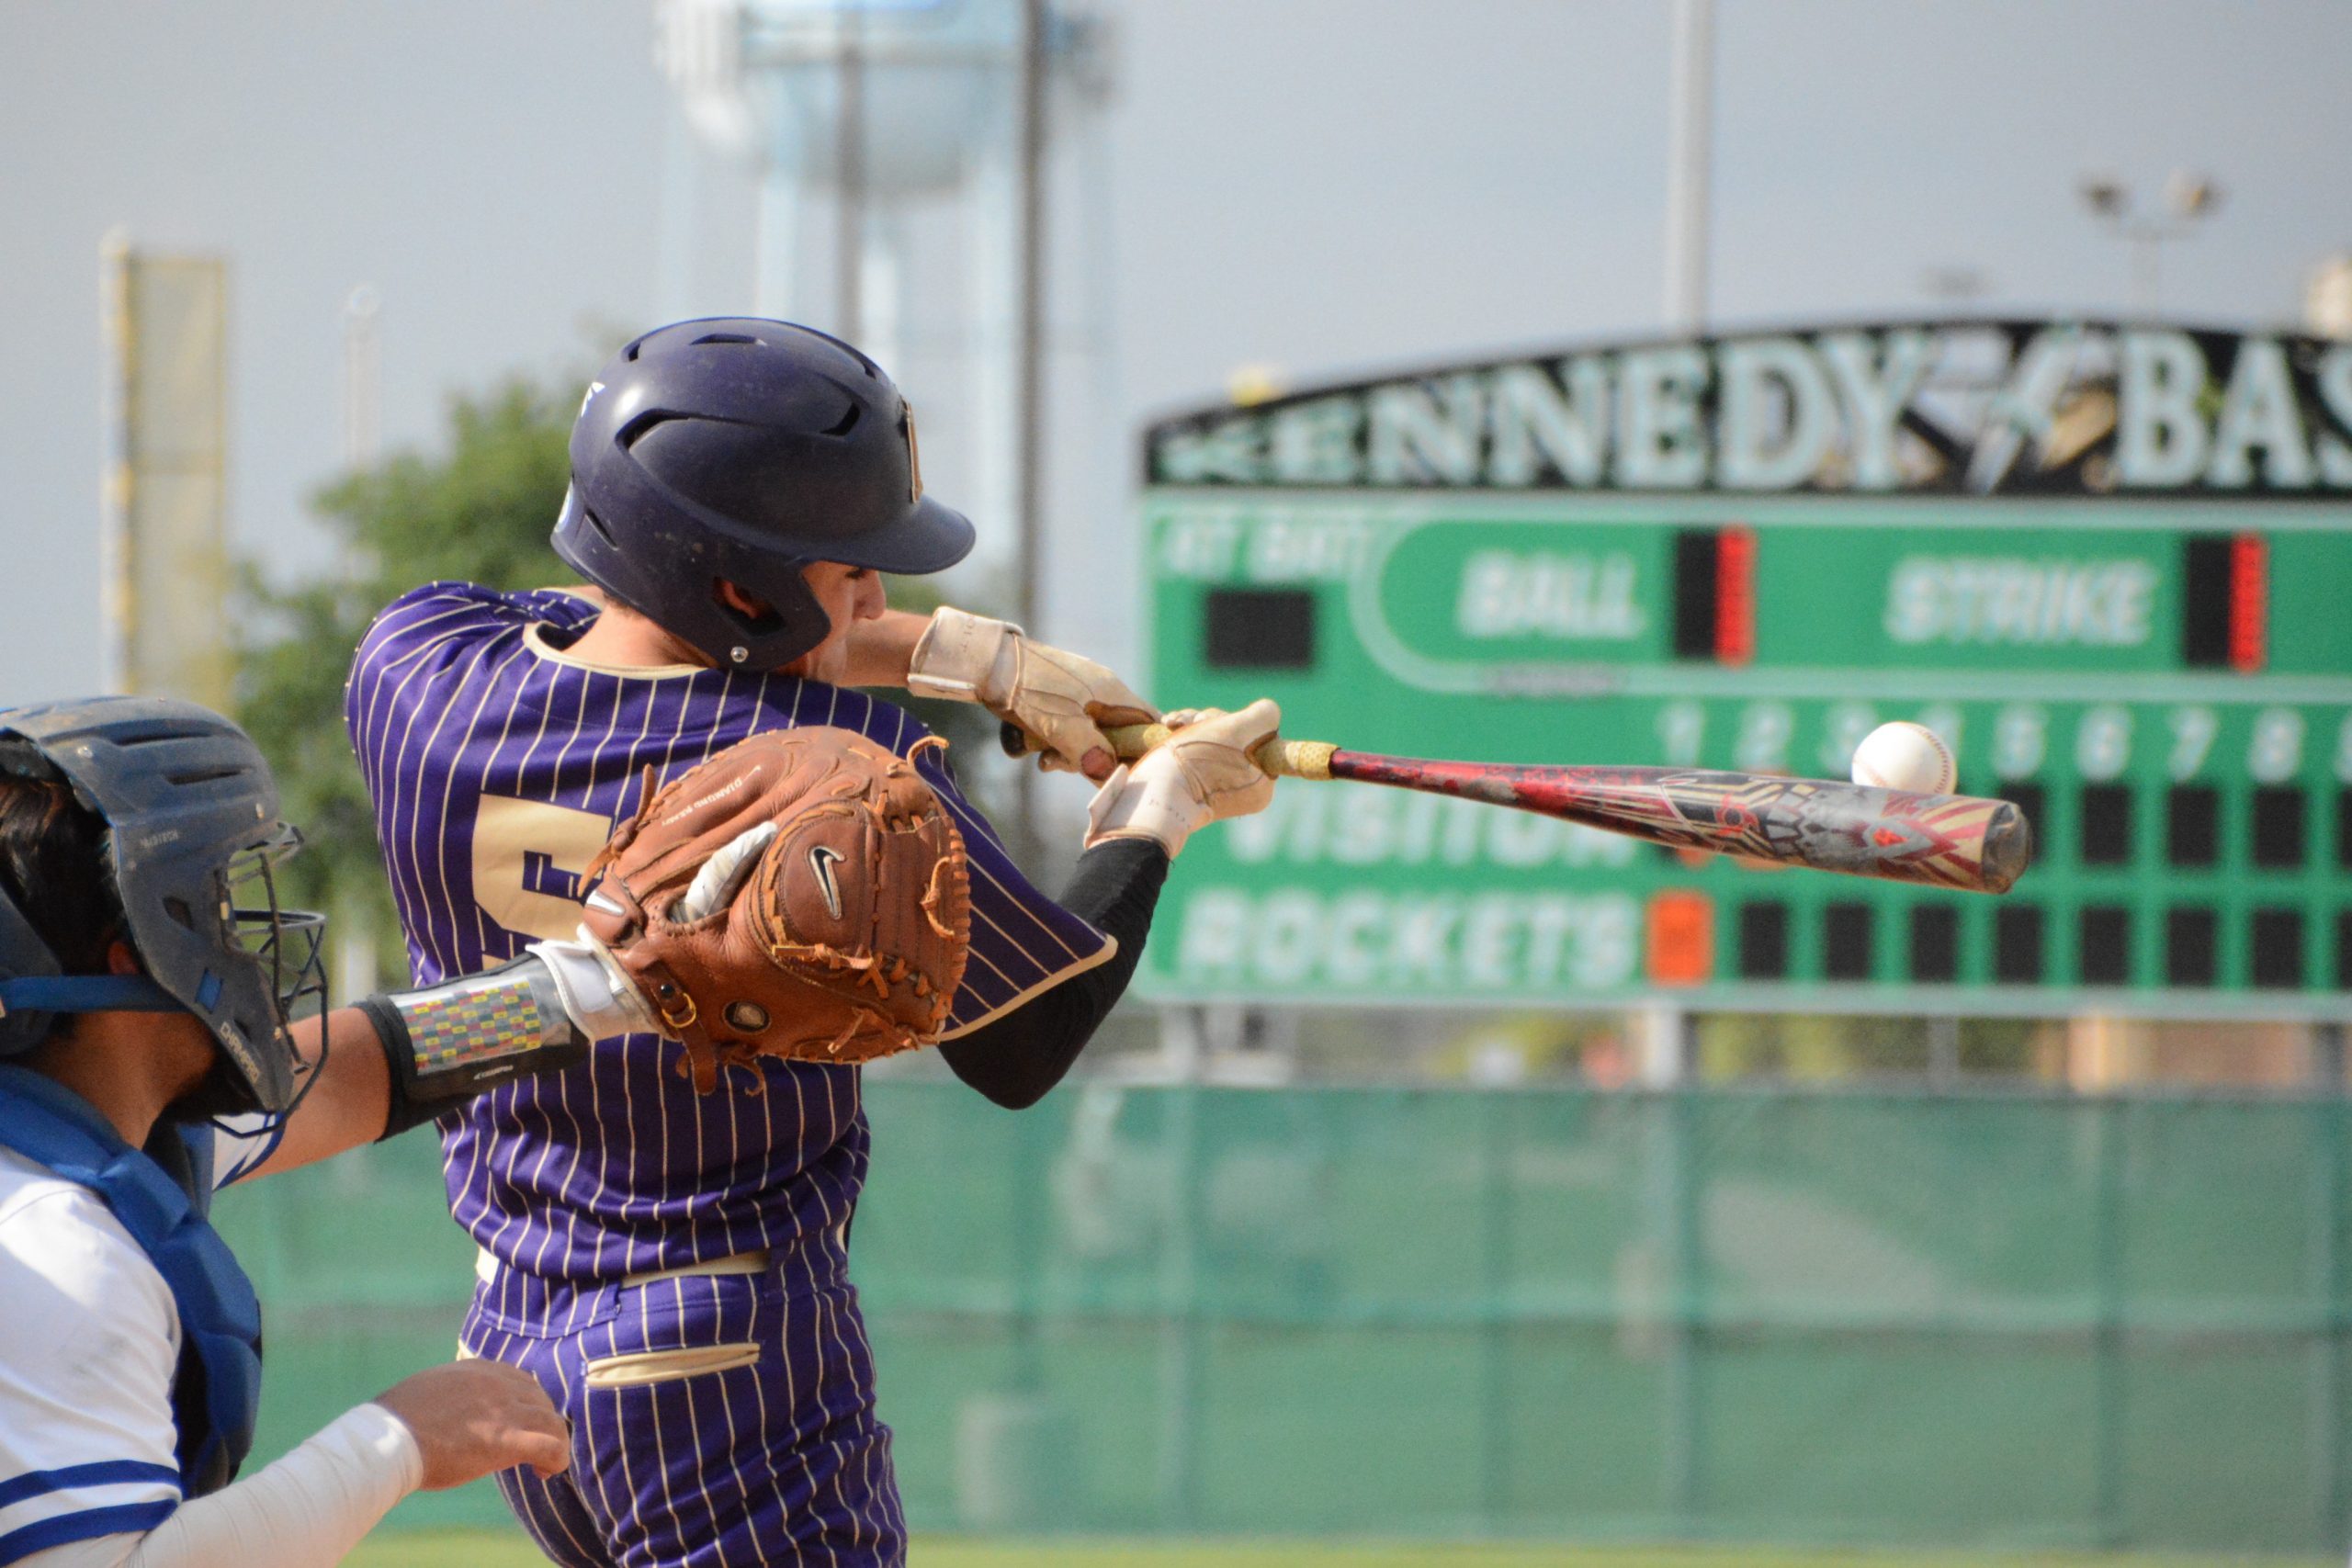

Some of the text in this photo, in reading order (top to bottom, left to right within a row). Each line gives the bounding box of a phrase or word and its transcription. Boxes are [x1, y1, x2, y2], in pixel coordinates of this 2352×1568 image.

[1156, 330, 1928, 488] KENNEDY
[1459, 551, 1646, 640] BALL
[1883, 556, 2159, 647] STRIKE
[2165, 707, 2220, 785] 7
[1178, 888, 1641, 986] ROCKETS
